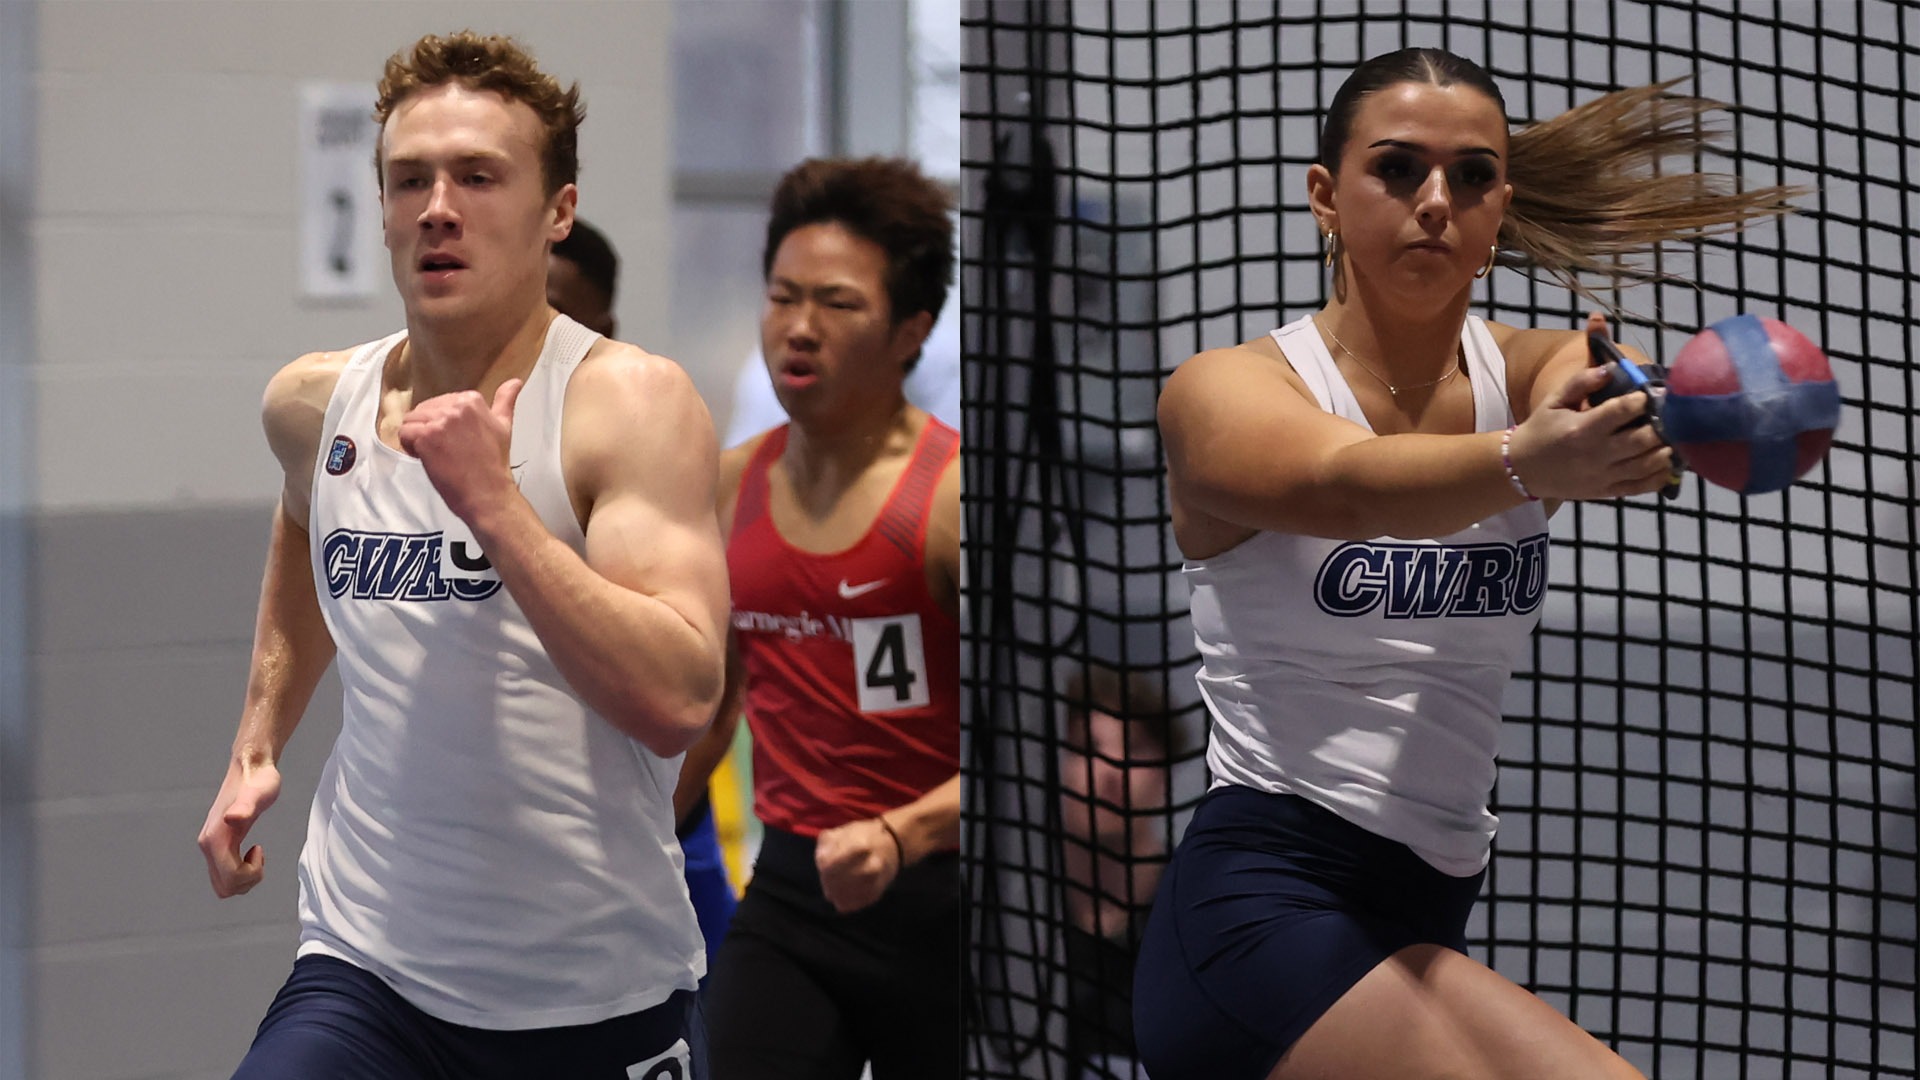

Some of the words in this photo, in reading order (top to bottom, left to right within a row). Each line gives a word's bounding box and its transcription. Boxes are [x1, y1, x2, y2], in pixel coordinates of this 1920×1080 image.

[1313, 533, 1549, 619] CWRU
[731, 610, 824, 643] arnegie
[866, 623, 915, 701] 4
